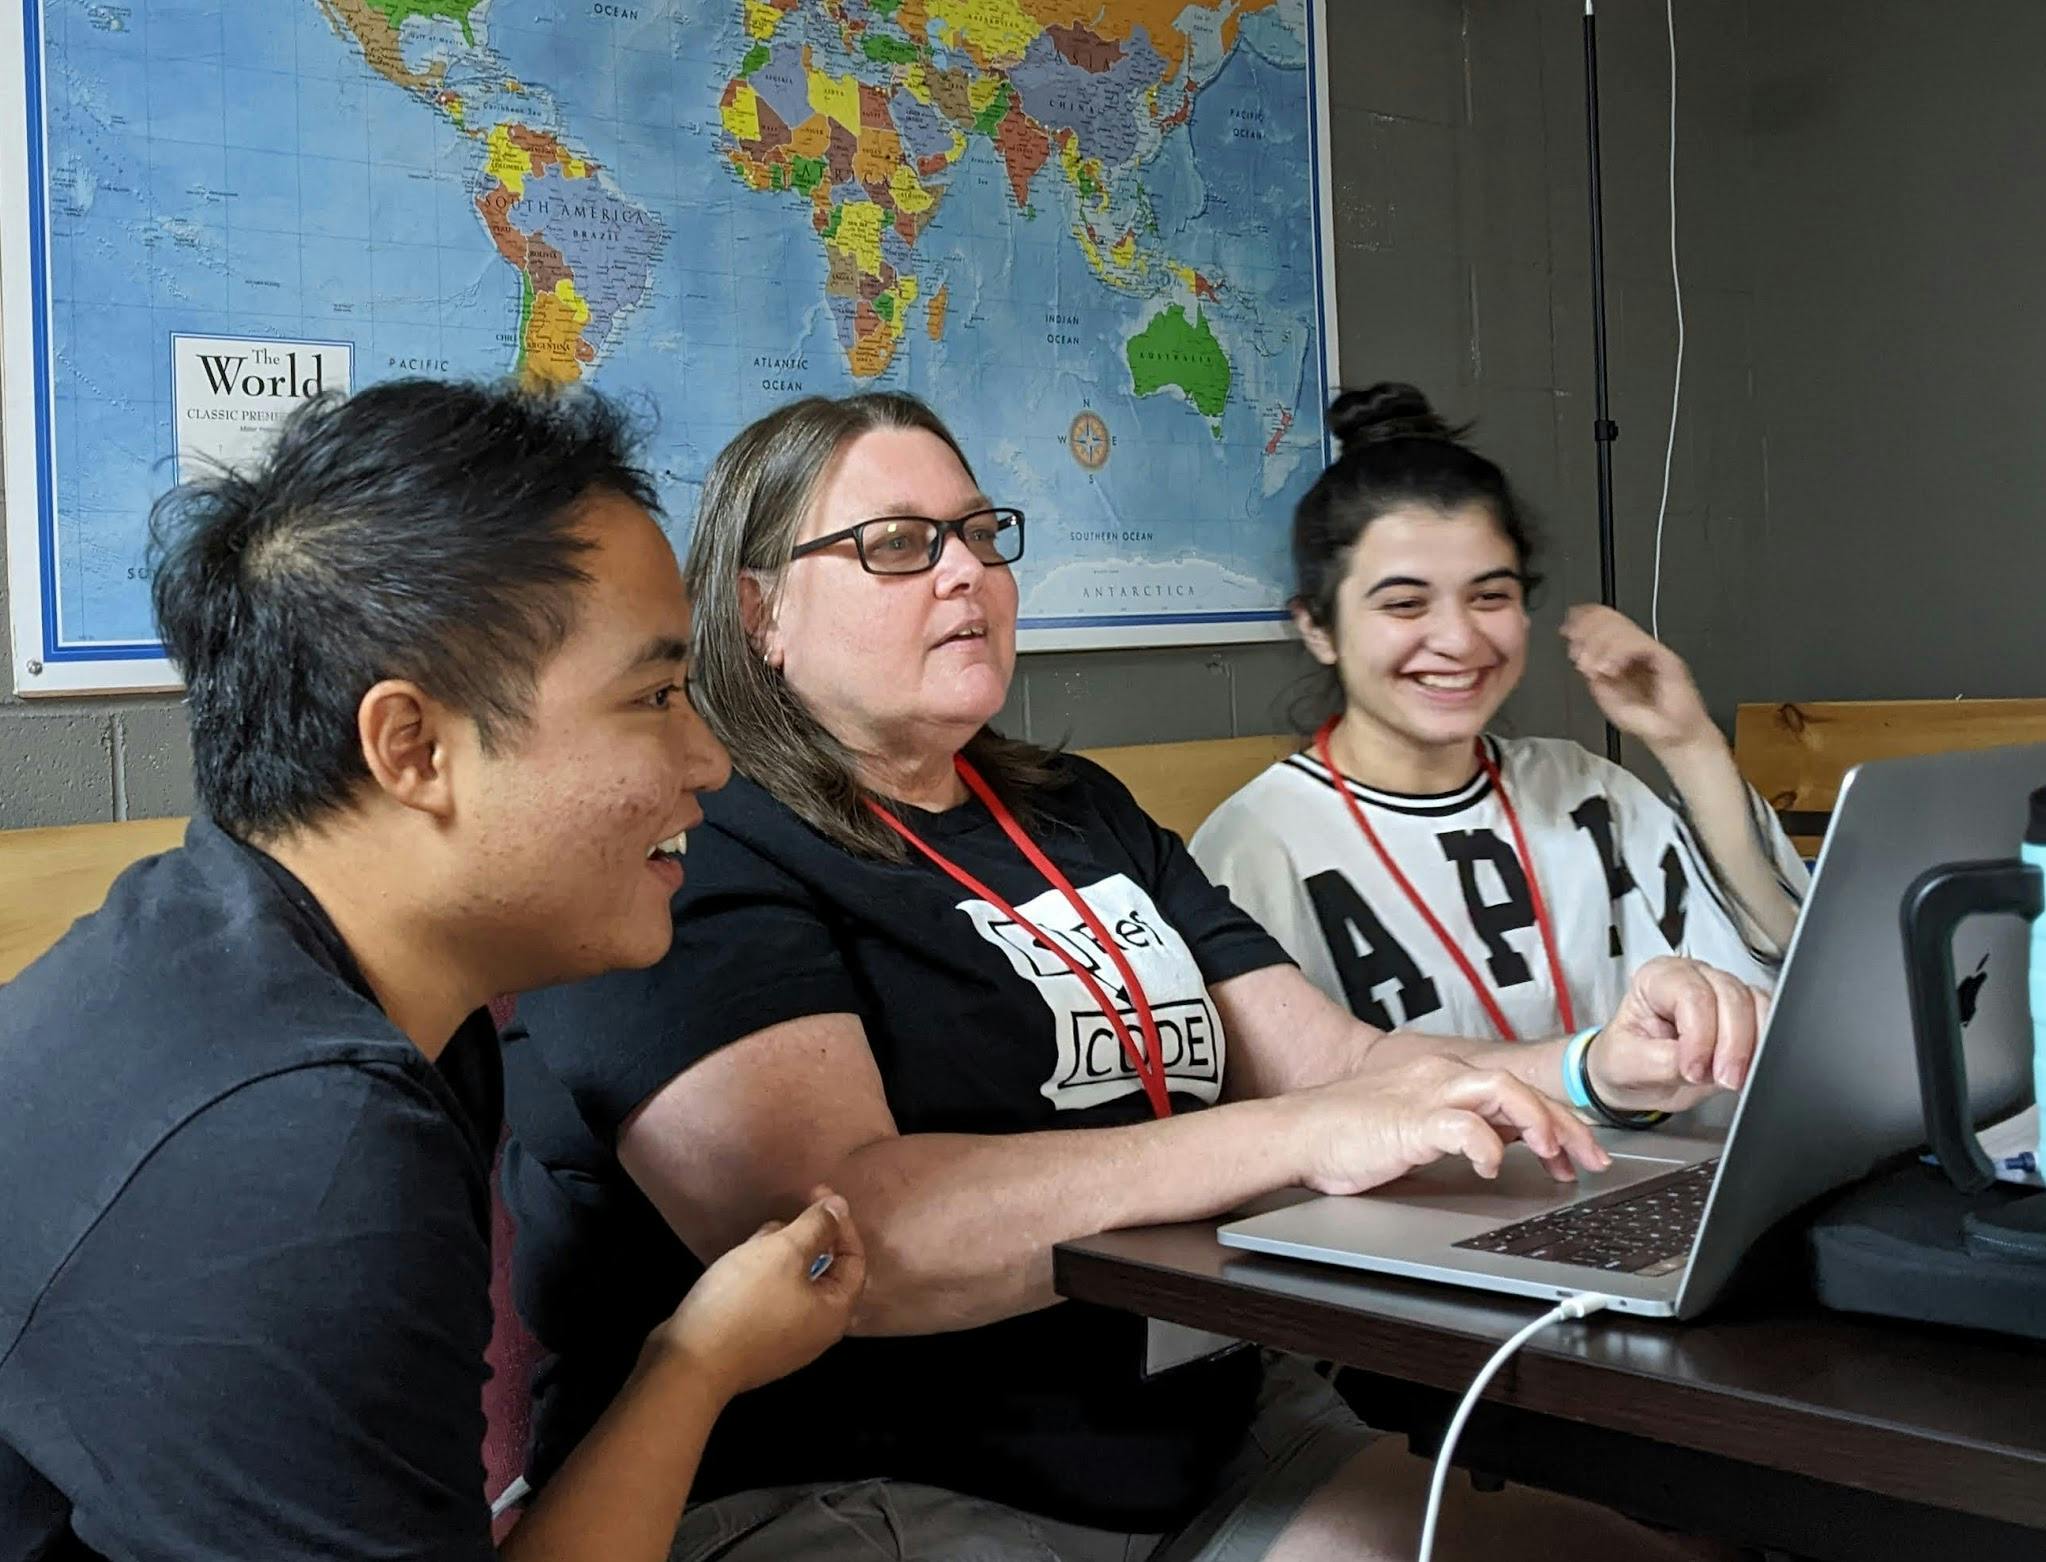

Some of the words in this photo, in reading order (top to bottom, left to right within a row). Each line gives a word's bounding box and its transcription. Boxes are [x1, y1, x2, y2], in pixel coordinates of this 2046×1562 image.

[594, 3, 639, 20] OCEAN
[1233, 128, 1262, 140] OCEAN
[484, 196, 549, 214] SOUTH
[561, 204, 644, 225] AMERICA
[573, 230, 620, 242] BRAZIL
[1045, 314, 1079, 325] INDIAN
[1046, 334, 1080, 345] OCEAN
[251, 348, 280, 365] The
[388, 358, 450, 372] PACIFIC
[753, 357, 809, 370] ATLANTIC
[196, 352, 323, 400] World
[762, 380, 803, 391] OCEAN
[1083, 398, 1091, 408] N
[187, 408, 239, 421] CLASSIC
[1057, 435, 1067, 444] W
[1112, 436, 1118, 446] E
[1089, 474, 1095, 484] S
[1070, 532, 1118, 541] SOUTHERN
[1122, 532, 1153, 541] OCEAN
[1083, 585, 1195, 598] ANTARCTICA
